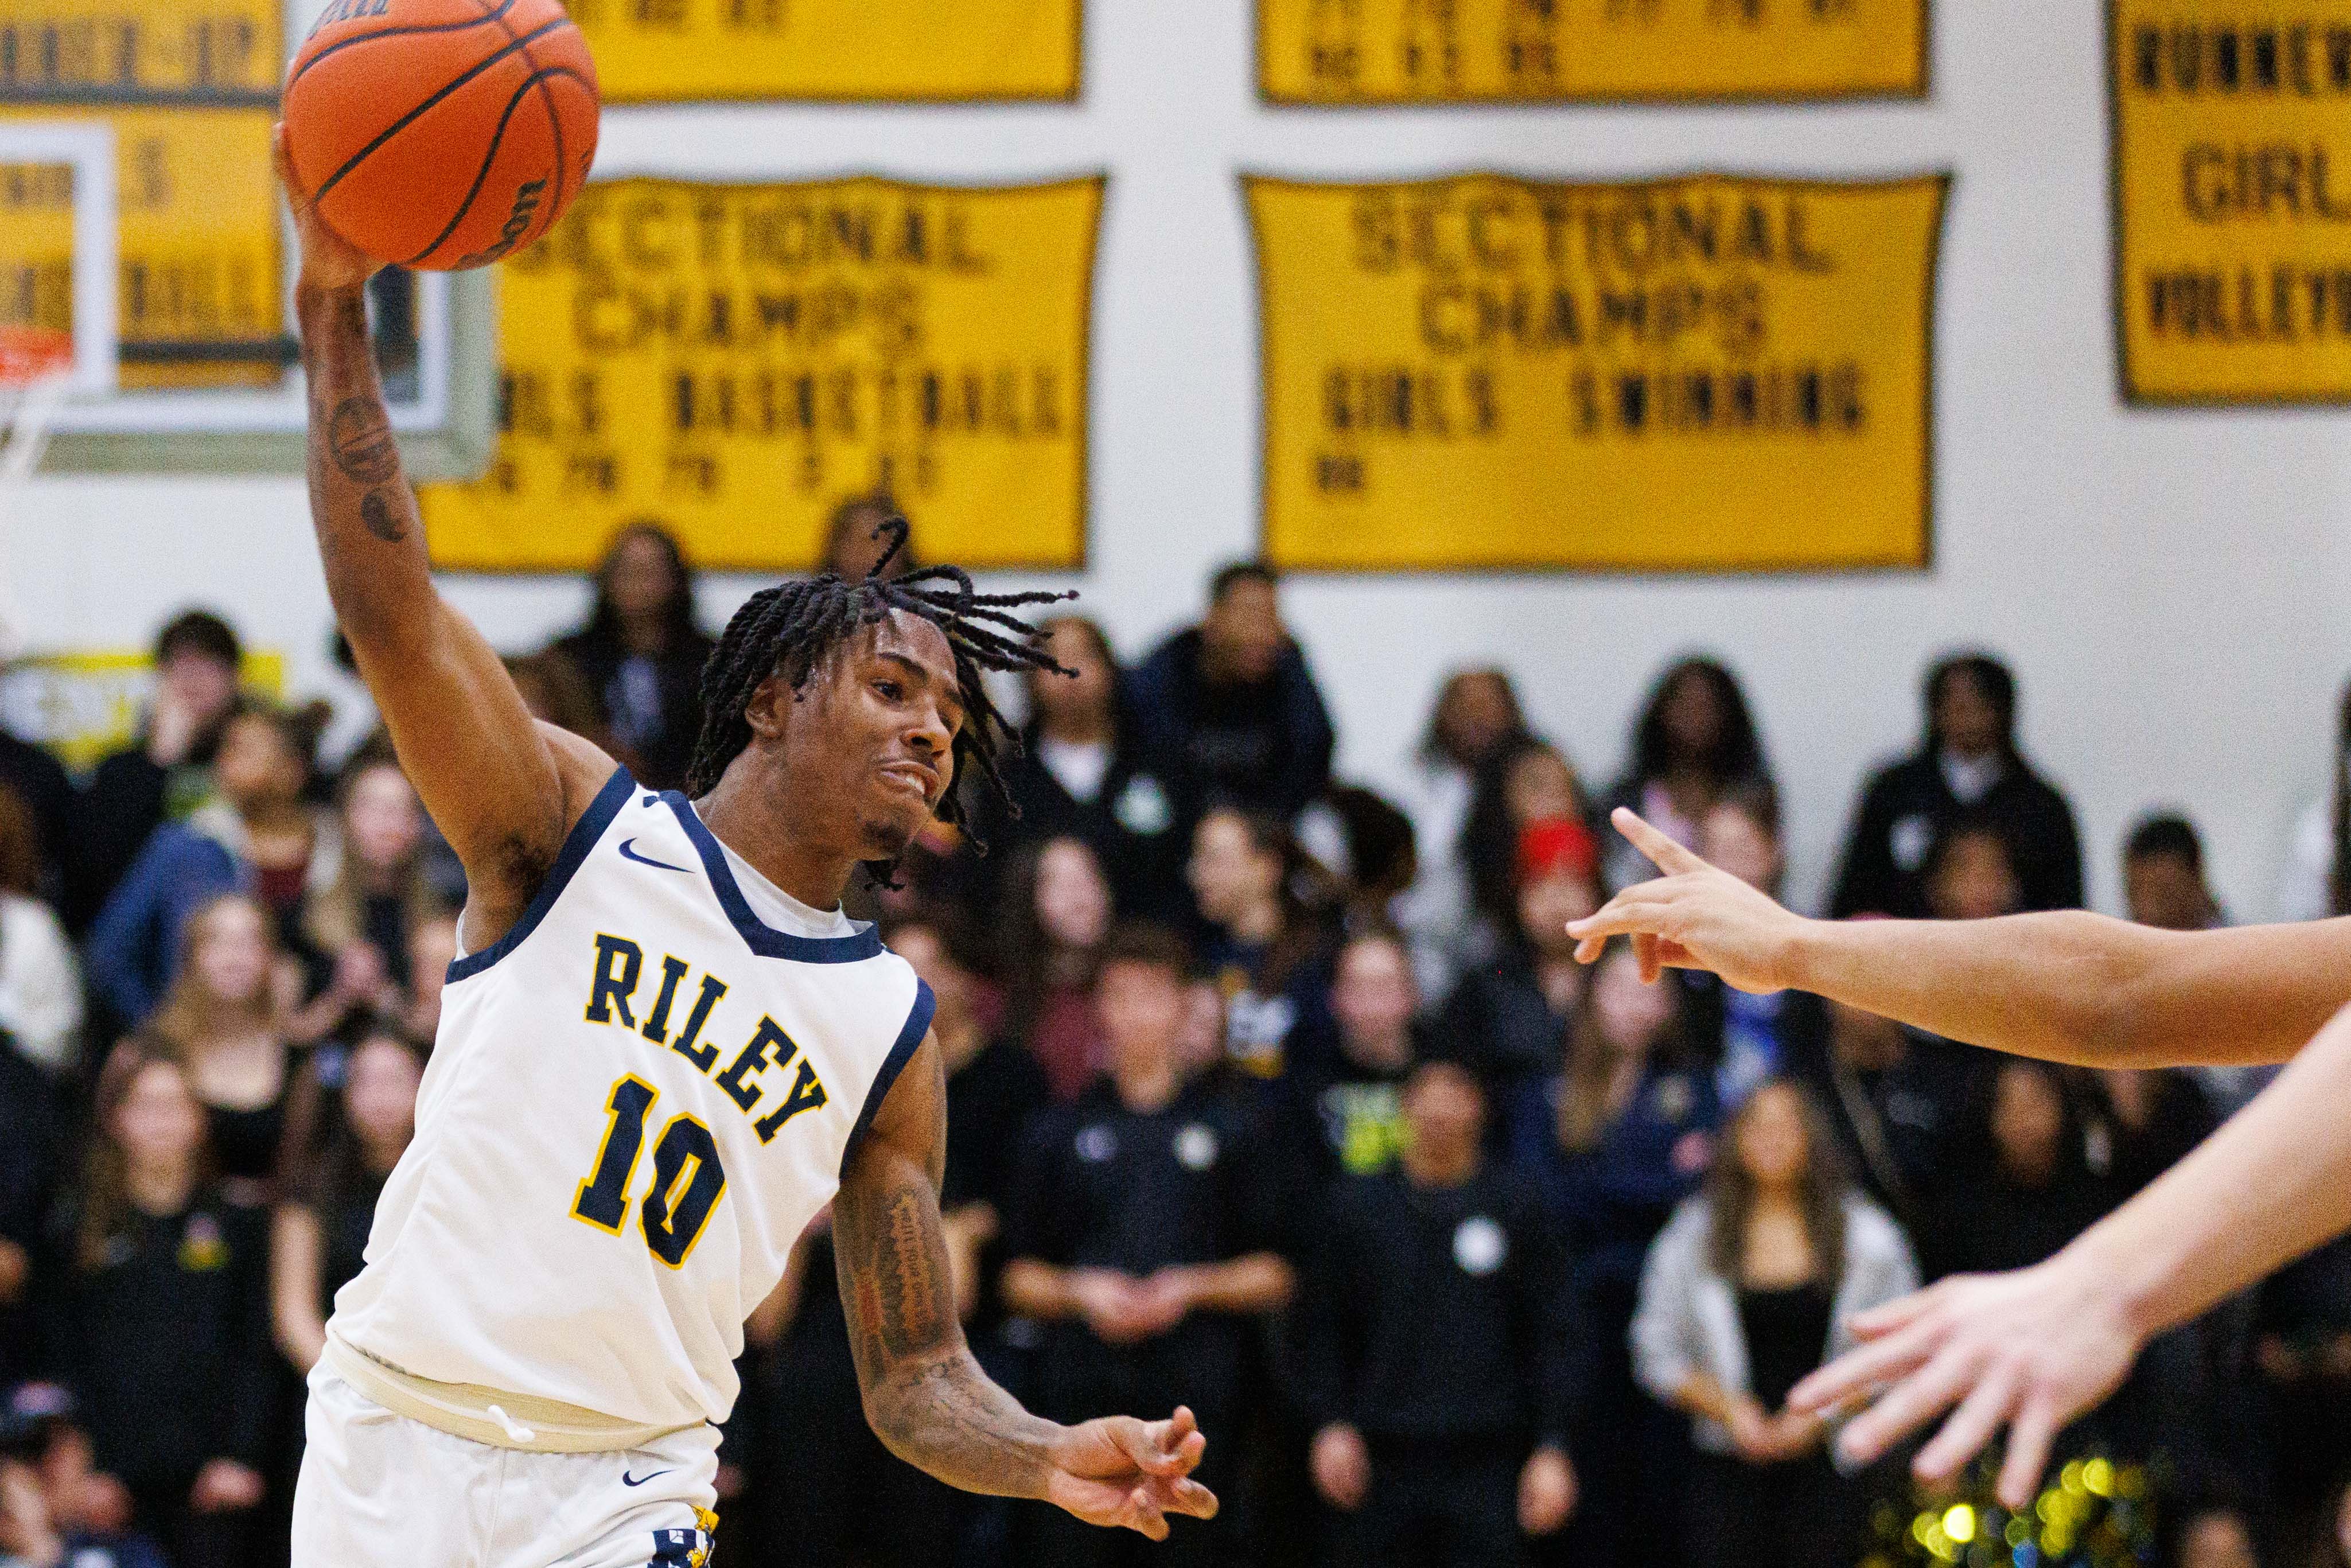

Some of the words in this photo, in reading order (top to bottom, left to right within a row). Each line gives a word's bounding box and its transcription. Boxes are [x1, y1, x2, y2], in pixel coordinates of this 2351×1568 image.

[1351, 198, 1837, 275] SECTIONAL
[573, 275, 926, 359] CHAMPS
[1417, 277, 1769, 359] CHAMPS
[668, 361, 1064, 442] BASKETBALL
[1323, 363, 1502, 442] GIRLS
[1571, 361, 1869, 442] SWIMMING
[584, 931, 830, 1146] RILEY
[568, 1072, 727, 1271] 10
